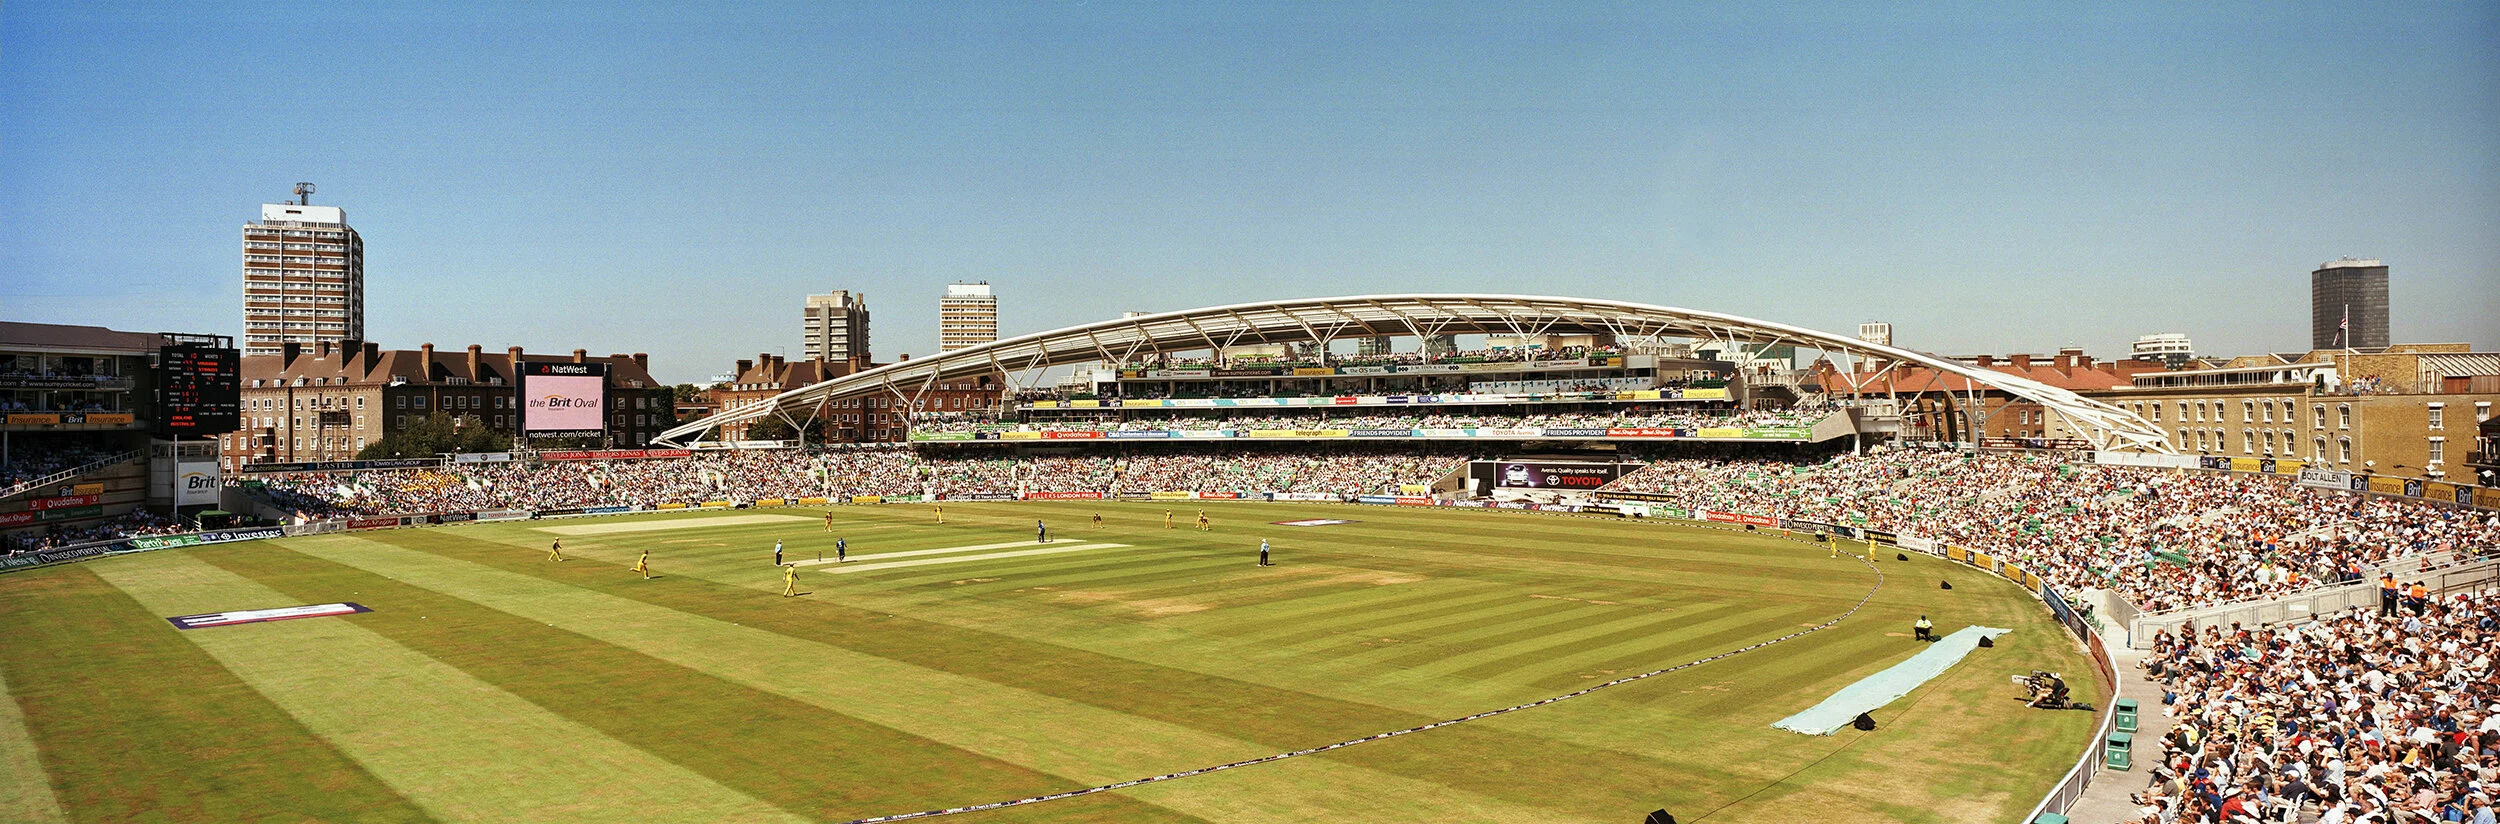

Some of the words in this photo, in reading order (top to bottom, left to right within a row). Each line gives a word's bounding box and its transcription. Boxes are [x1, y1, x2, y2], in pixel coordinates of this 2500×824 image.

[551, 365, 588, 374] NatWest
[28, 381, 96, 389] www.surreycricket.com
[529, 398, 545, 408] the
[549, 397, 572, 408] Brit
[574, 397, 598, 408] Oval
[11, 415, 51, 424] Insurance
[67, 415, 84, 424] Brit
[88, 415, 124, 424] Insurance
[528, 430, 601, 439] natwest.com/cricket
[317, 461, 353, 470] EASTER
[2218, 460, 2231, 470] Brit
[2232, 460, 2260, 470] Insurance
[2263, 462, 2276, 472] Brit
[2277, 462, 2299, 472] Insuran
[1558, 467, 1573, 475] Quality
[1562, 476, 1603, 486] TOYOTA
[2302, 471, 2319, 480] BOLT
[2320, 473, 2341, 482] ALLEN
[188, 475, 216, 489] Brit
[2355, 477, 2368, 490] Brit
[2370, 479, 2401, 492] Insurance
[2407, 485, 2421, 497] Brit
[2423, 485, 2453, 500] Insurance
[2459, 490, 2472, 504] Brit
[53, 497, 84, 507] vodafone
[1453, 499, 1484, 507] NatWest
[1496, 501, 1525, 509] NatWest
[440, 513, 470, 522] NatWest
[1712, 512, 1734, 520] vodafone
[1747, 515, 1769, 524] vodafone
[232, 529, 281, 540] Investec
